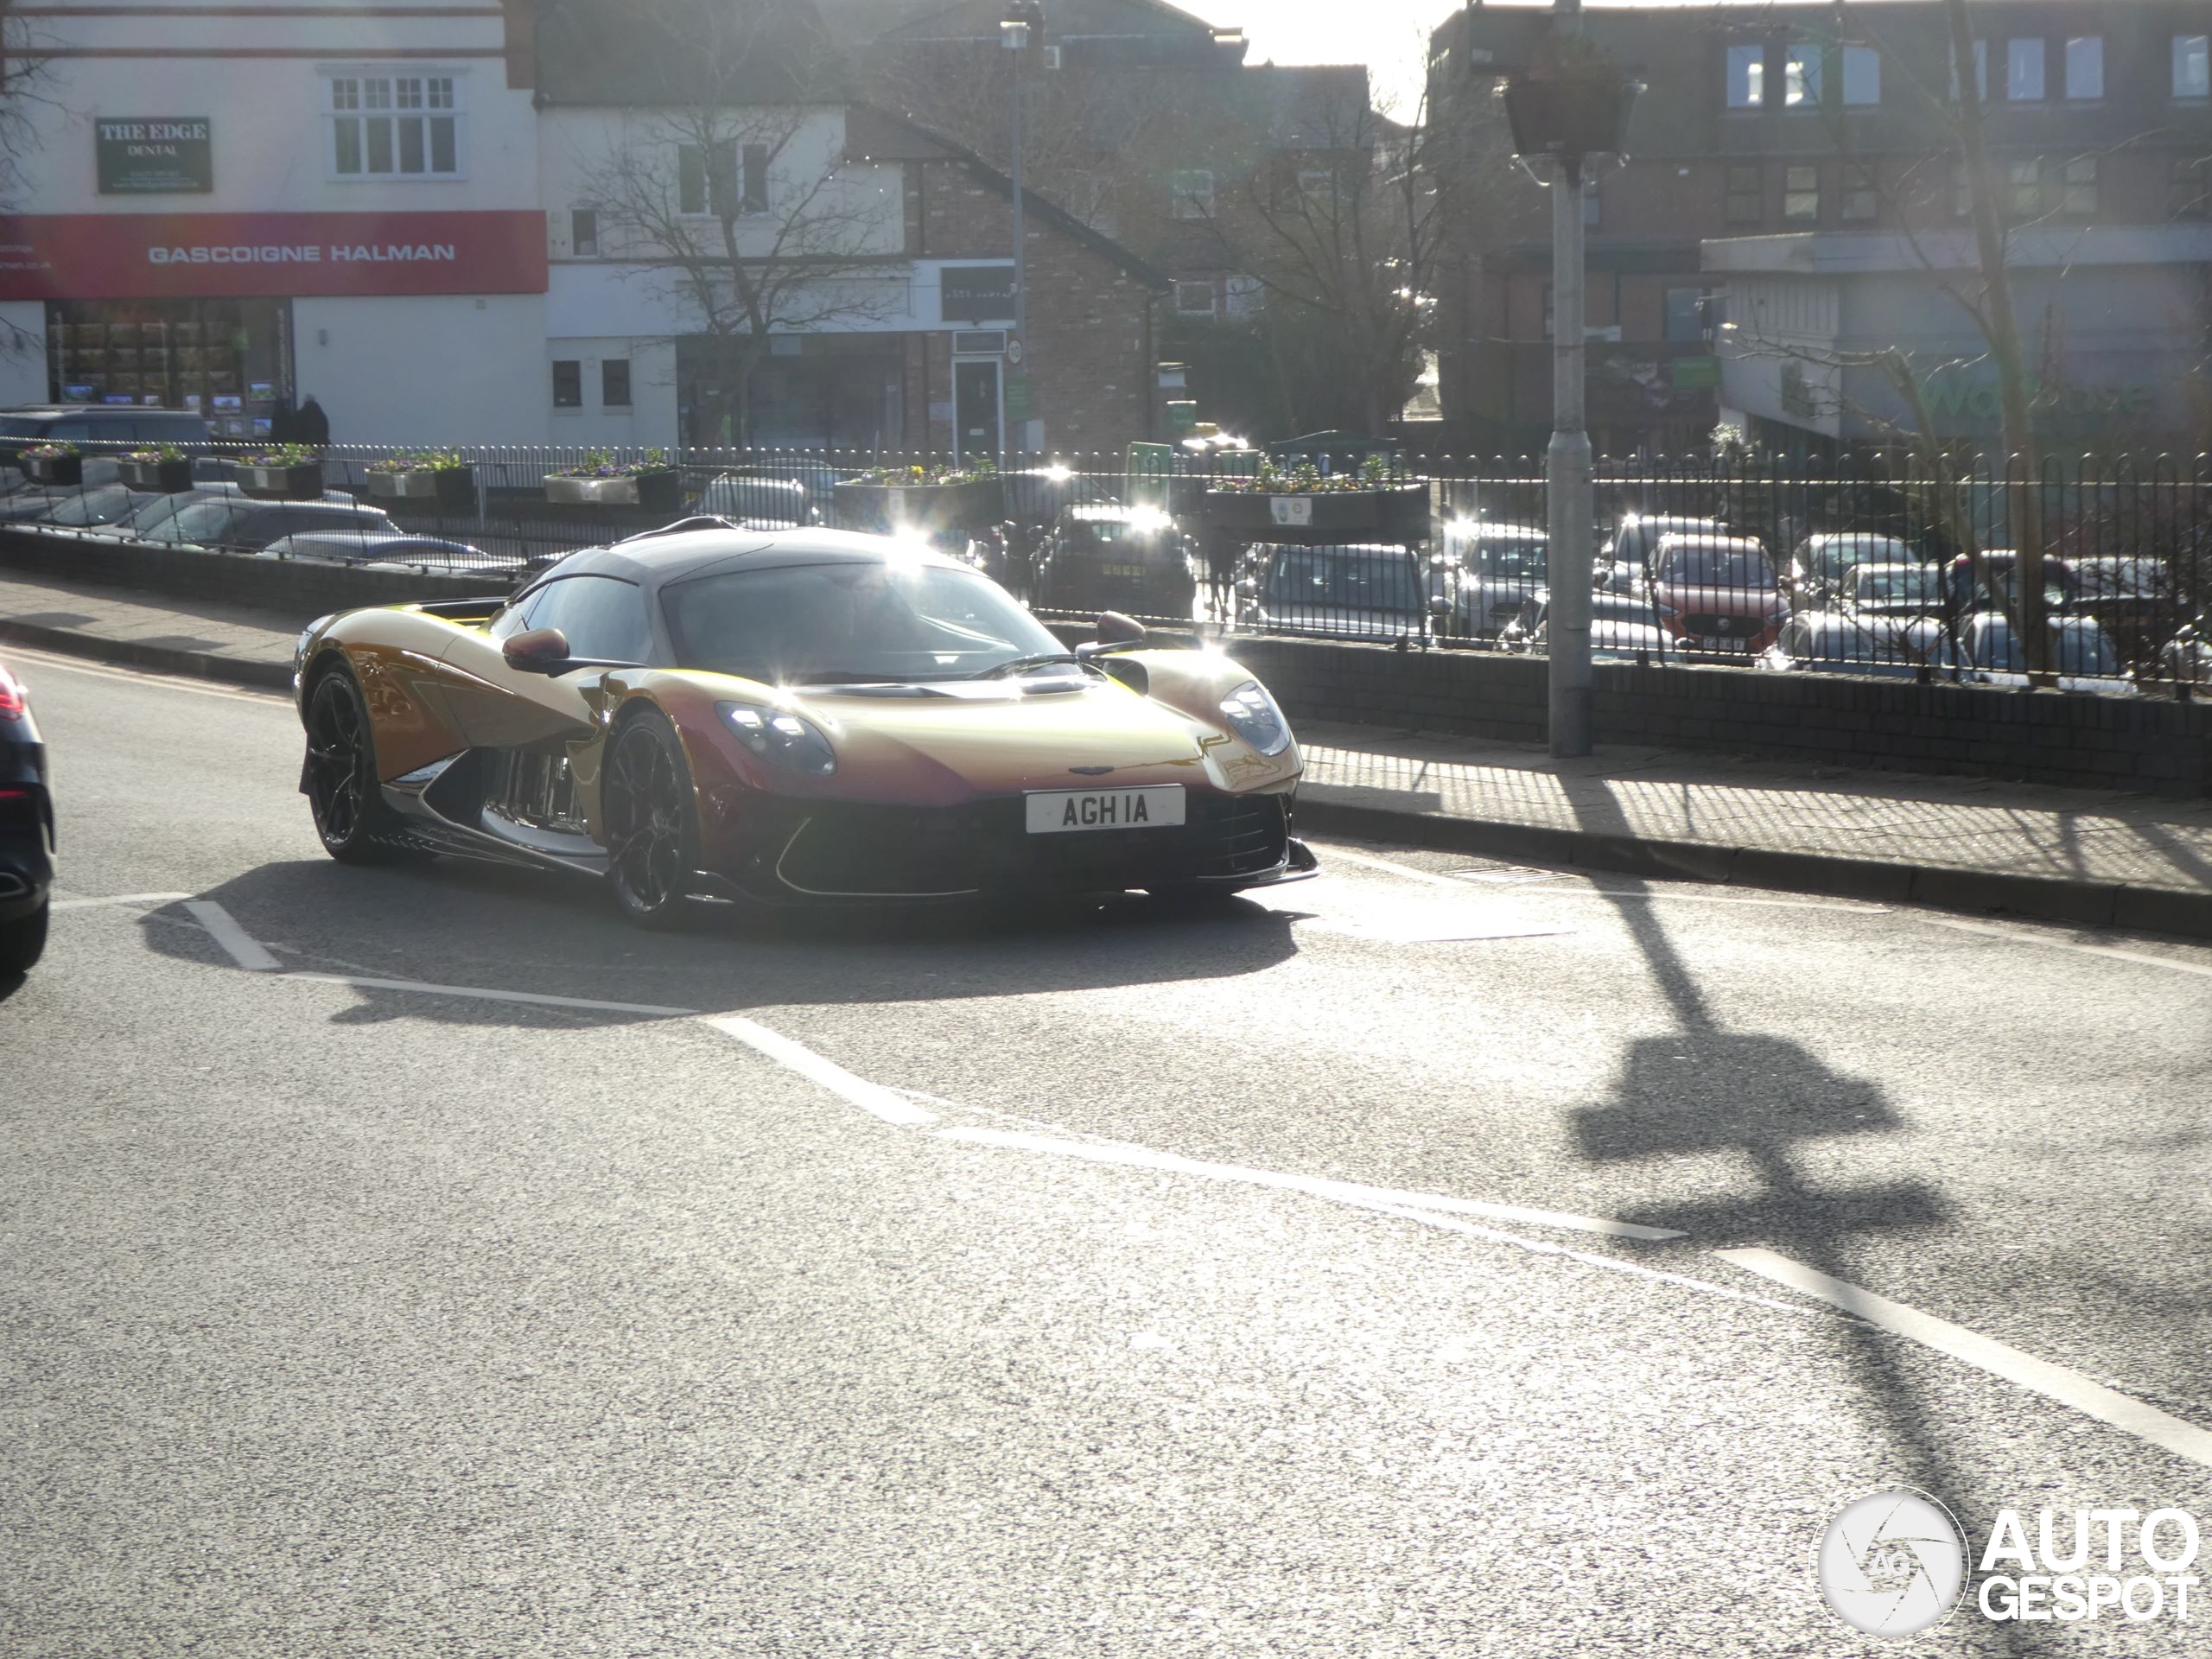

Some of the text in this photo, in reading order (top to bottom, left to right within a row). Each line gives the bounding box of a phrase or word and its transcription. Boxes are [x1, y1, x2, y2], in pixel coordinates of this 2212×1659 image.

[100, 124, 207, 140] THE EDGE
[127, 144, 178, 156] DENTAL
[148, 244, 455, 264] GASCOIGNE HALMAN
[1062, 795, 1116, 826] AGH
